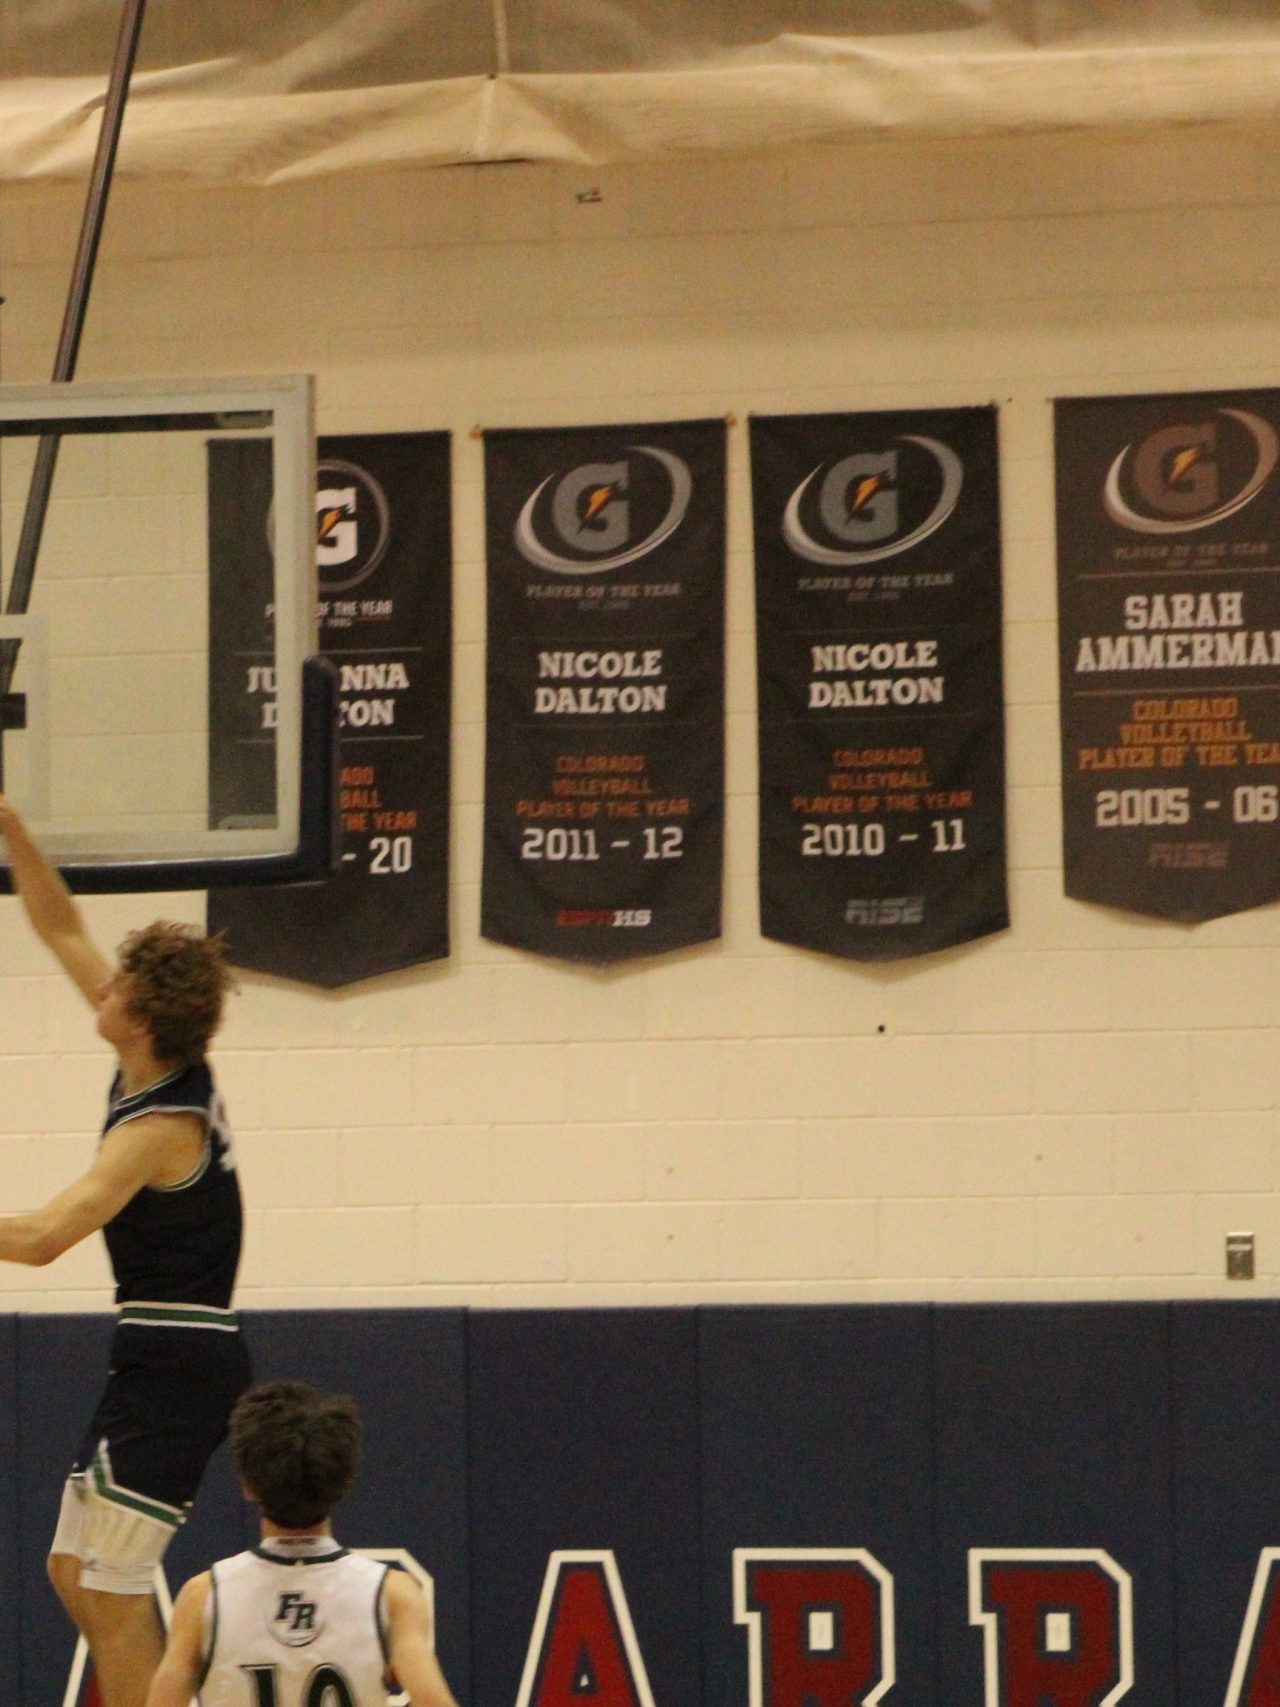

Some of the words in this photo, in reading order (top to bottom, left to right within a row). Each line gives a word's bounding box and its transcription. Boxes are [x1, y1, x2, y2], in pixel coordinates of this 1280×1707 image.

[553, 462, 629, 553] G
[821, 451, 898, 543] G
[334, 601, 358, 616] THE
[360, 600, 393, 615] YEAR
[1124, 592, 1244, 630] SARAH
[538, 650, 663, 678] NICOLE
[811, 640, 938, 672] NICOLE
[534, 685, 668, 713] DALTON
[808, 676, 945, 708] DALTON
[1132, 697, 1238, 720] COLORADO
[1120, 720, 1252, 743] VOLLEYBALL
[556, 755, 646, 773] COLORADO
[833, 749, 924, 767] COLORADO
[1078, 746, 1155, 770] PLAYER
[1161, 746, 1189, 767] OF
[1195, 745, 1238, 766] THE
[1245, 743, 1280, 764] YEA
[552, 778, 654, 796] VOLLEYBALL
[827, 772, 933, 790] VOLLEYBALL
[516, 800, 576, 817] PLAYER
[579, 801, 601, 818] OF
[607, 801, 640, 817] THE
[645, 798, 691, 816] YEAR
[792, 795, 854, 813] PLAYER
[858, 796, 880, 813] OF
[884, 795, 919, 812] THE
[925, 790, 972, 809] YEAR
[1096, 787, 1190, 827] 2005
[1233, 785, 1279, 823] 06
[373, 810, 417, 831] YEAR
[521, 828, 600, 860] 2011
[643, 826, 684, 860] 12
[801, 823, 885, 856] 2010
[931, 819, 966, 852] 11
[369, 836, 412, 874] 20
[275, 1592, 317, 1630] FR
